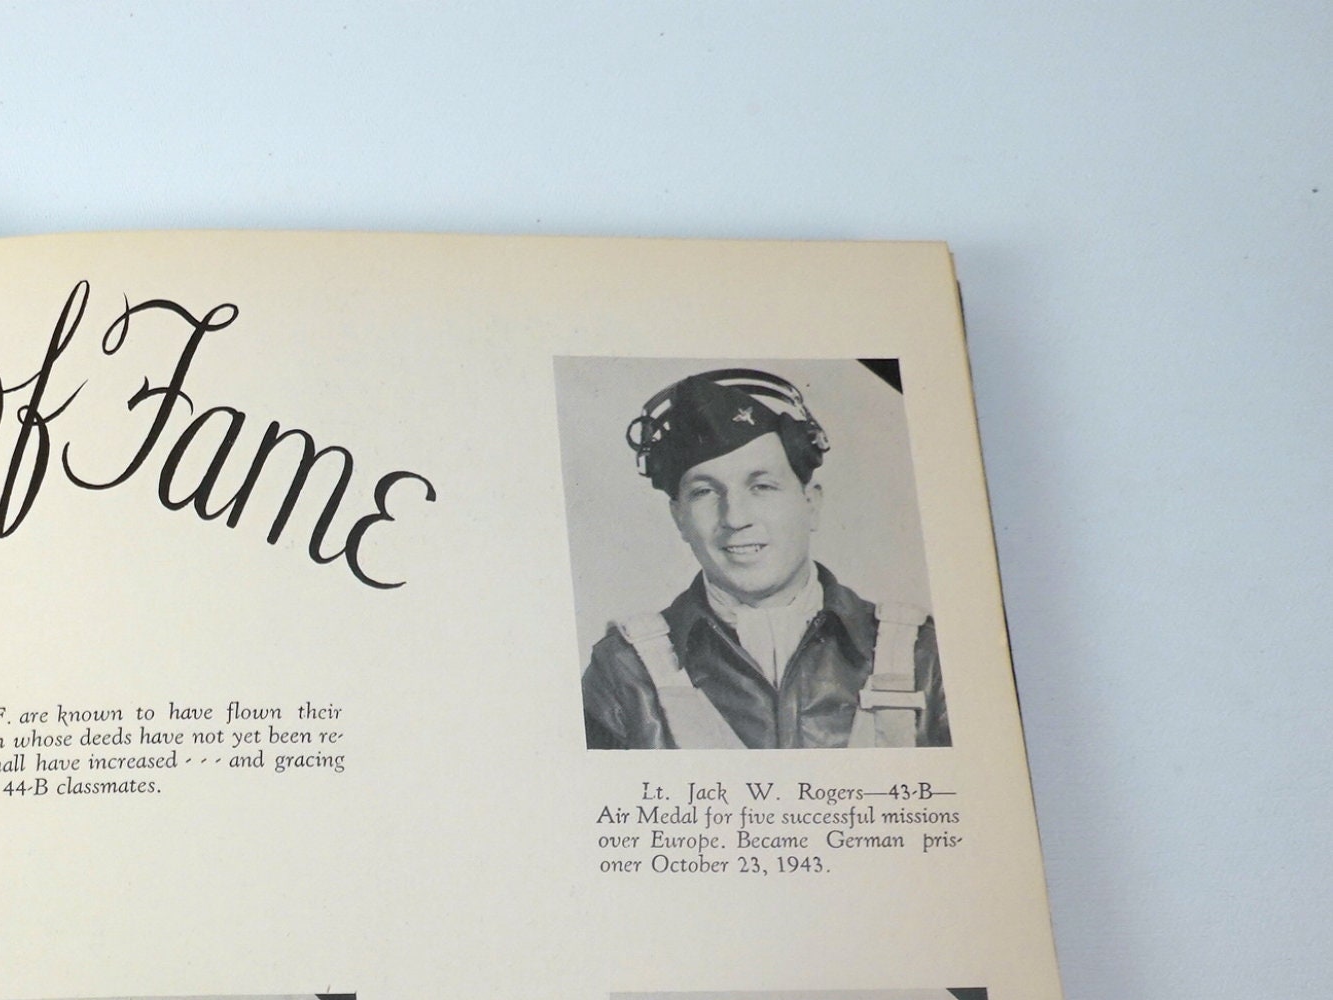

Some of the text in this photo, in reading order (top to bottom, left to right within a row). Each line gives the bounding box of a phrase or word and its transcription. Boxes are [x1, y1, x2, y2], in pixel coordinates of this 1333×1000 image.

[63, 291, 438, 591] Fame
[18, 711, 49, 725] are
[56, 703, 124, 728] known
[135, 706, 155, 721] to
[168, 701, 214, 721] have
[225, 700, 283, 726] flown
[297, 700, 343, 721] their
[13, 728, 73, 749] whose
[79, 725, 133, 747] deeds
[139, 725, 185, 745] have
[191, 729, 225, 745] not
[231, 729, 262, 749] yet
[267, 724, 313, 745] been
[1, 777, 49, 797] 44-B
[56, 775, 162, 796] classmates.
[641, 781, 670, 801] Lt.
[687, 781, 730, 806] Jack
[745, 782, 781, 801] W.
[595, 805, 960, 830] Air Medal for five successful missions
[597, 829, 963, 854] over Europe. Became German pris-
[599, 853, 831, 877] oner October 23, 1943.
